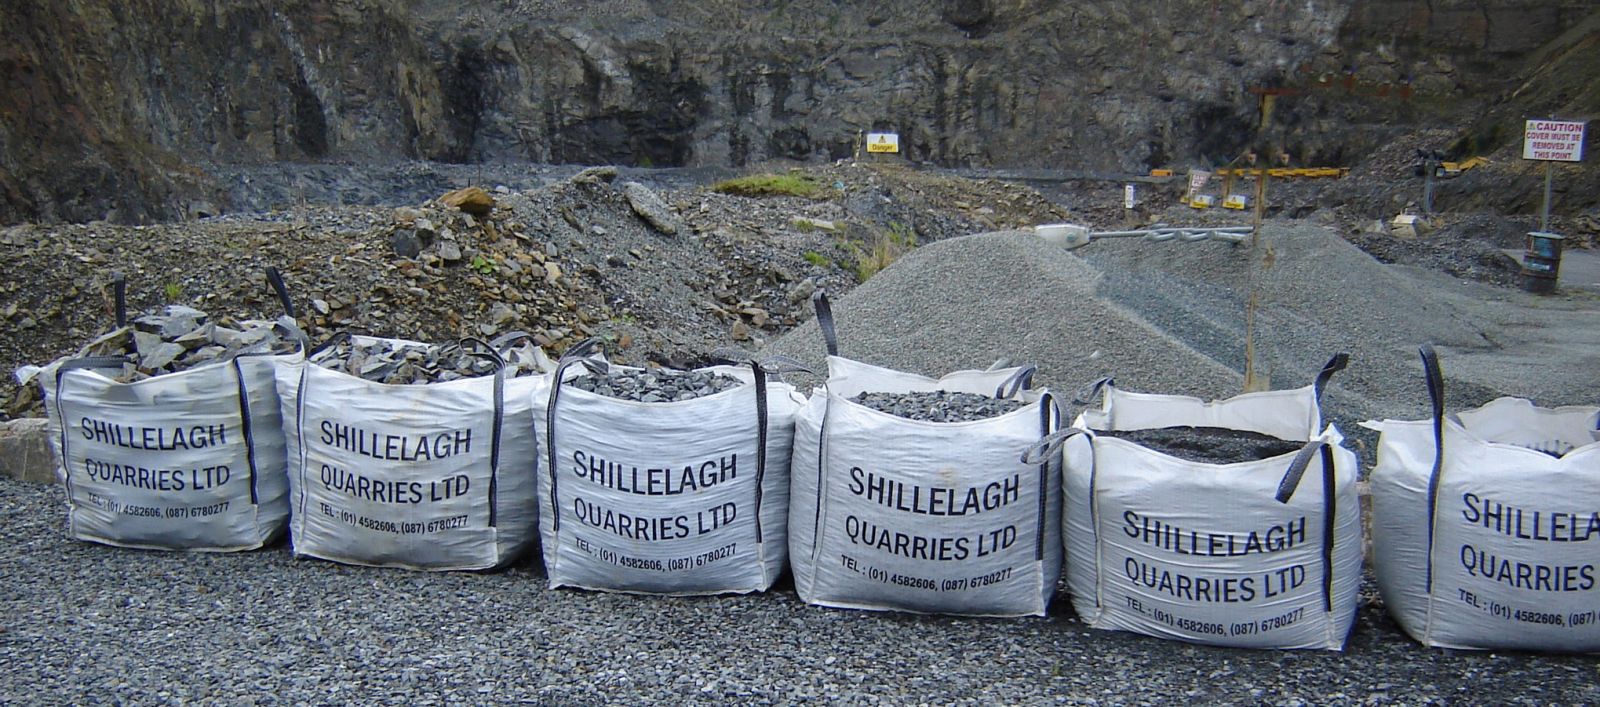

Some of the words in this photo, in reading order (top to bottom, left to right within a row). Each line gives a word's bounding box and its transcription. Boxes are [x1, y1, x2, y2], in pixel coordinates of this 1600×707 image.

[1526, 132, 1549, 140] COVER
[1536, 122, 1582, 132] CAUTION
[1532, 141, 1565, 150] REMOVED
[81, 416, 226, 451] SHILLELAGH
[320, 420, 472, 461] SHILLELAGH
[85, 458, 185, 491] QUARRIES
[192, 465, 230, 491] LTD
[320, 464, 422, 504] QUARRIES
[430, 474, 470, 502] LTD
[573, 450, 737, 495] SHILLELAGH
[848, 466, 1019, 516] SHILLELAGH
[341, 509, 356, 527] (01)
[401, 521, 425, 535] (087)
[428, 515, 468, 533] 6780277
[574, 497, 689, 541] QUARRIES
[698, 501, 737, 535] LTD
[1123, 510, 1306, 557] SHILLELAGH
[845, 515, 969, 561] QUARRIES
[977, 524, 1016, 558] LTD
[599, 547, 617, 565] (01)
[668, 556, 693, 572] (087)
[696, 543, 737, 566] 6780277
[1460, 544, 1595, 592] QUARRIES
[868, 566, 888, 584] (01)
[941, 577, 968, 592] (087)
[970, 567, 1012, 588] 6780277
[1125, 556, 1255, 603] QUARRIES
[1264, 564, 1306, 598] LTD
[1154, 607, 1174, 627] (01)
[1230, 621, 1258, 636] (087)
[1261, 607, 1304, 632] 6780277
[1489, 602, 1511, 620] (01)
[1568, 610, 1595, 628] (087)
